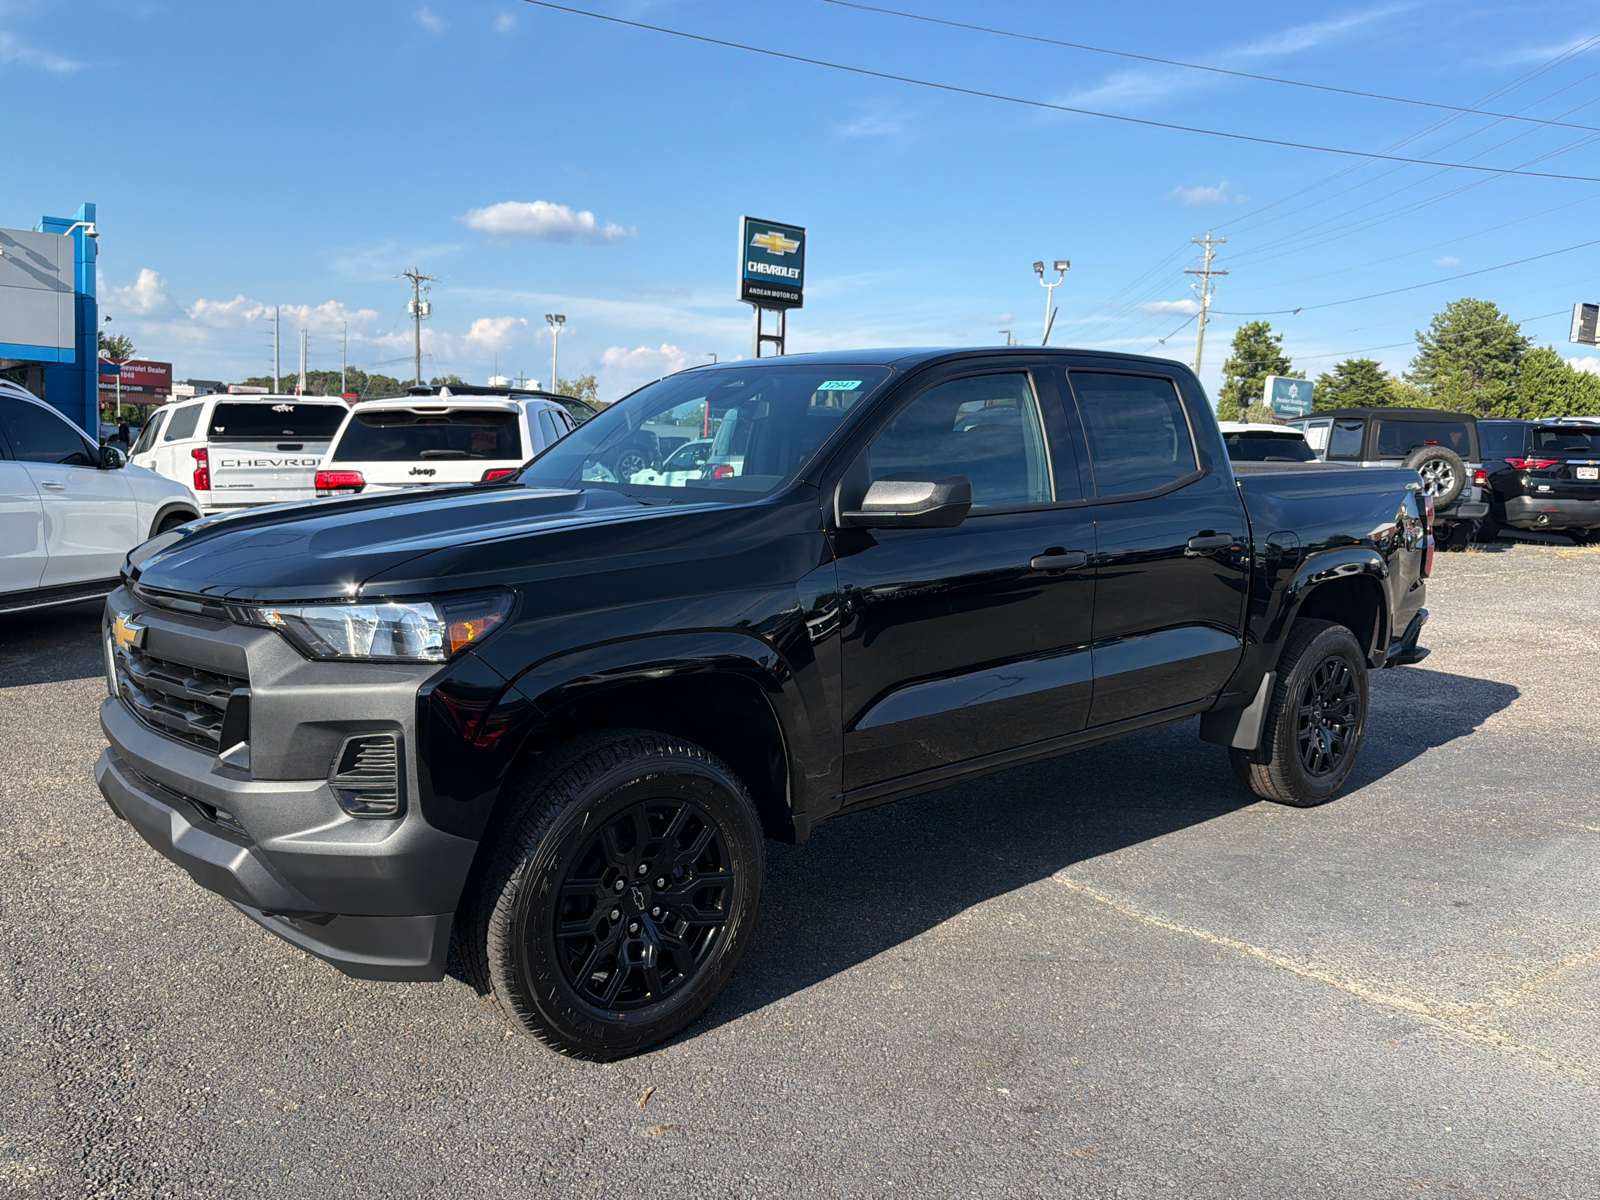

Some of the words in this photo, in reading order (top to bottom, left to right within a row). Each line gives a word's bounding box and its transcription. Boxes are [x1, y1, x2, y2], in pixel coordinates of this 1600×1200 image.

[748, 261, 800, 279] CHEVROLET
[749, 287, 771, 296] ANDEAN
[772, 290, 790, 299] MOTOR
[120, 365, 146, 373] hevrolet
[148, 366, 166, 374] Dealer
[221, 459, 321, 467] CHEVRO
[408, 467, 436, 477] Jeep
